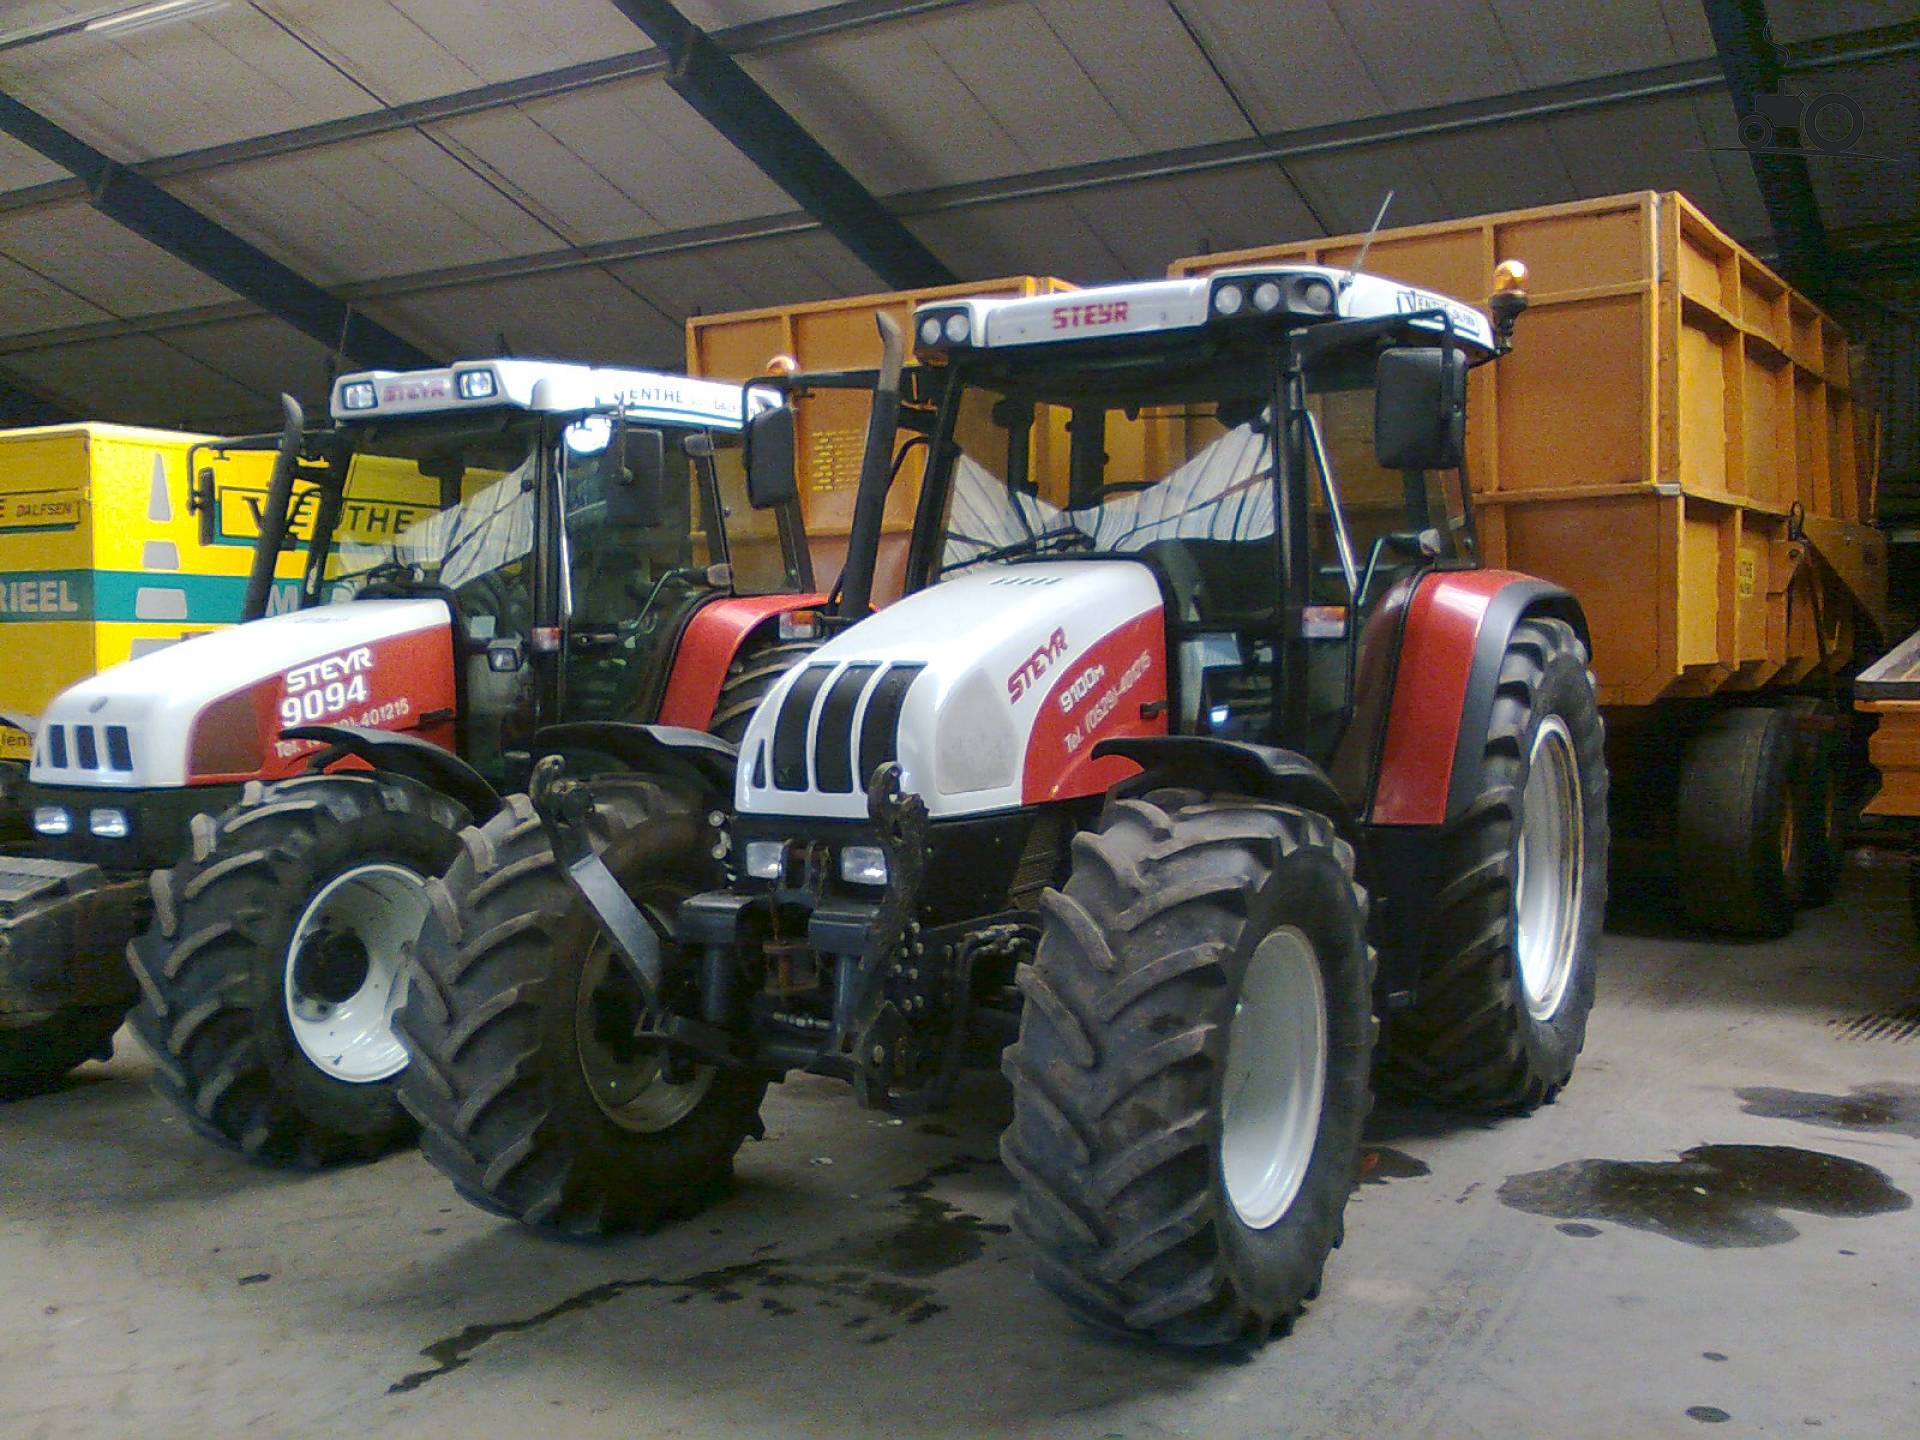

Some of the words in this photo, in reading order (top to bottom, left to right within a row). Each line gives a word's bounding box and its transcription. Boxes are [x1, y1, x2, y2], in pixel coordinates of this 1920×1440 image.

[1054, 302, 1128, 329] STEYR
[287, 647, 373, 693] STEYR
[1007, 626, 1068, 705] STEYR
[281, 674, 367, 727] 9094
